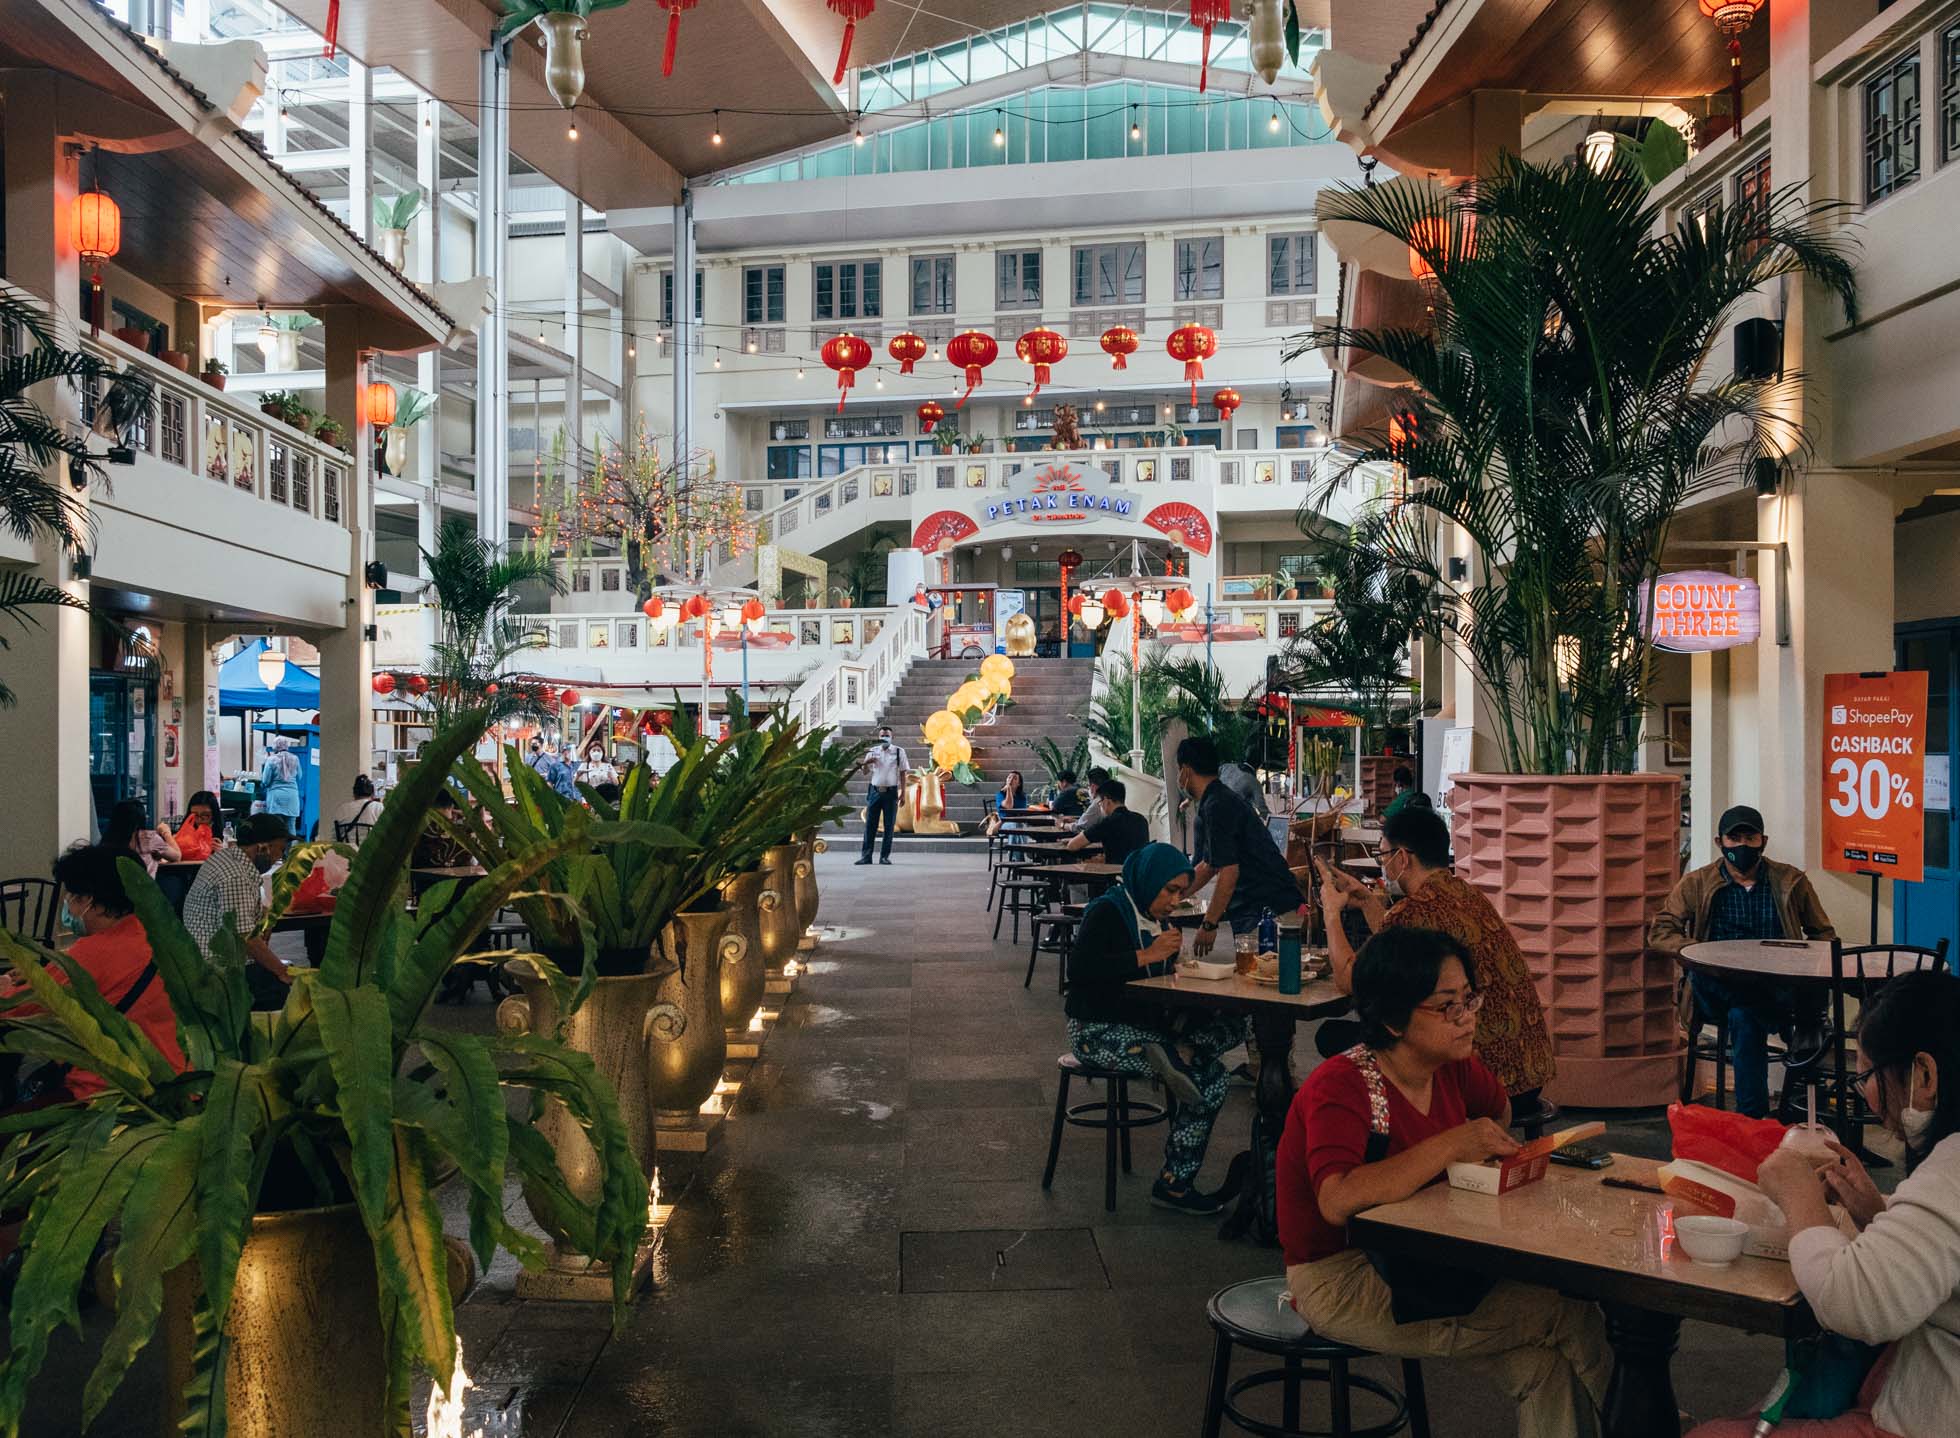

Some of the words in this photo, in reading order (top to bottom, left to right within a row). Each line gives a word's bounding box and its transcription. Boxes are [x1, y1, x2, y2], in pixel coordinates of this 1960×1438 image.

[988, 494, 1057, 519] PETAK
[1069, 493, 1131, 514] ENAM
[1655, 583, 1741, 610] COUNT
[1655, 611, 1740, 637] THREE
[1849, 708, 1914, 727] ShopeePay
[1831, 735, 1913, 754] CASHBACK
[1829, 757, 1914, 820] 30%
